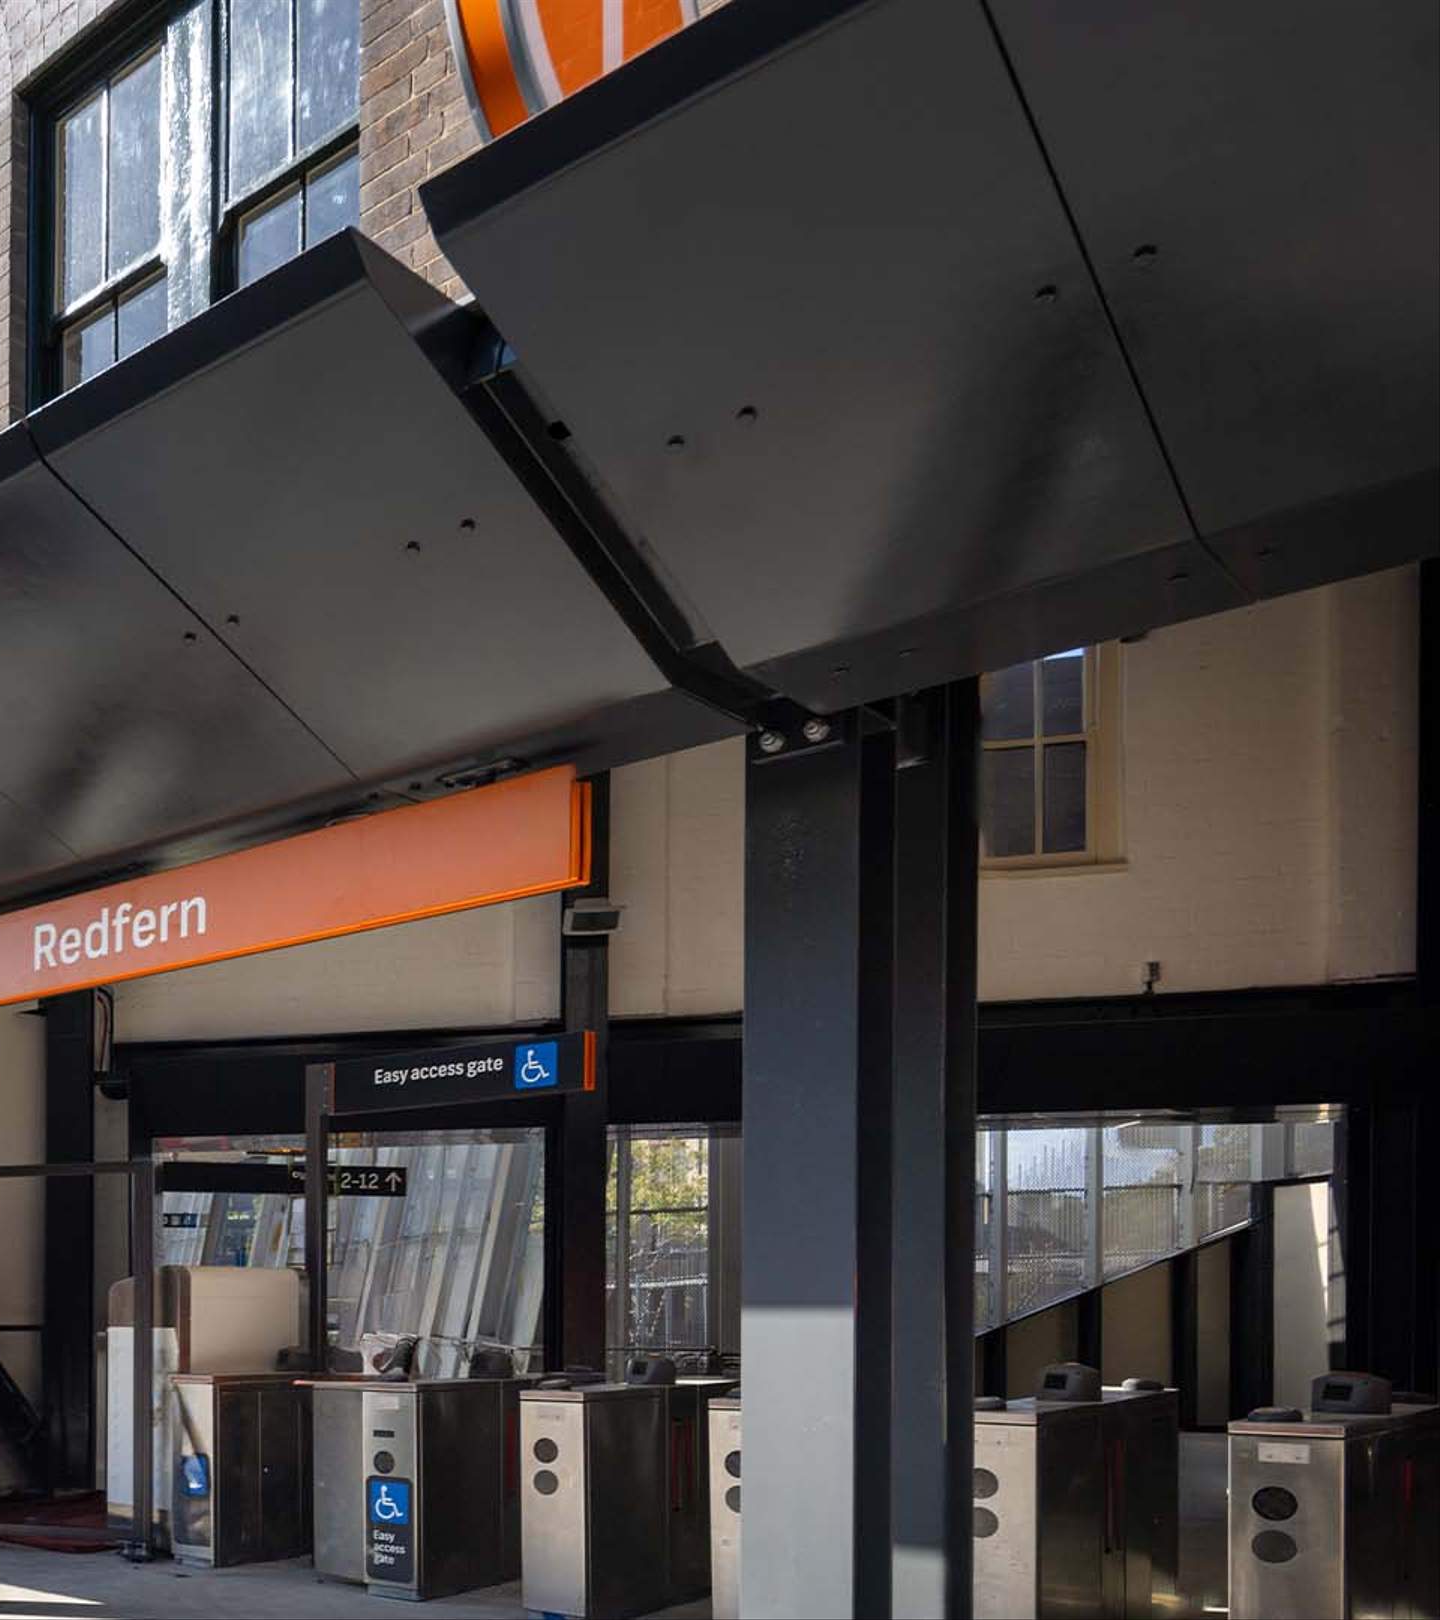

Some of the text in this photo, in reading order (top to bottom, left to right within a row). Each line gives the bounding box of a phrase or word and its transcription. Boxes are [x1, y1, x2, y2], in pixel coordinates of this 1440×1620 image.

[33, 894, 207, 971] Redfern
[374, 1056, 504, 1086] Easy access gate
[340, 1172, 379, 1189] 2-12
[373, 1529, 395, 1544] Easy
[373, 1543, 406, 1554] access
[373, 1553, 395, 1565] gate
